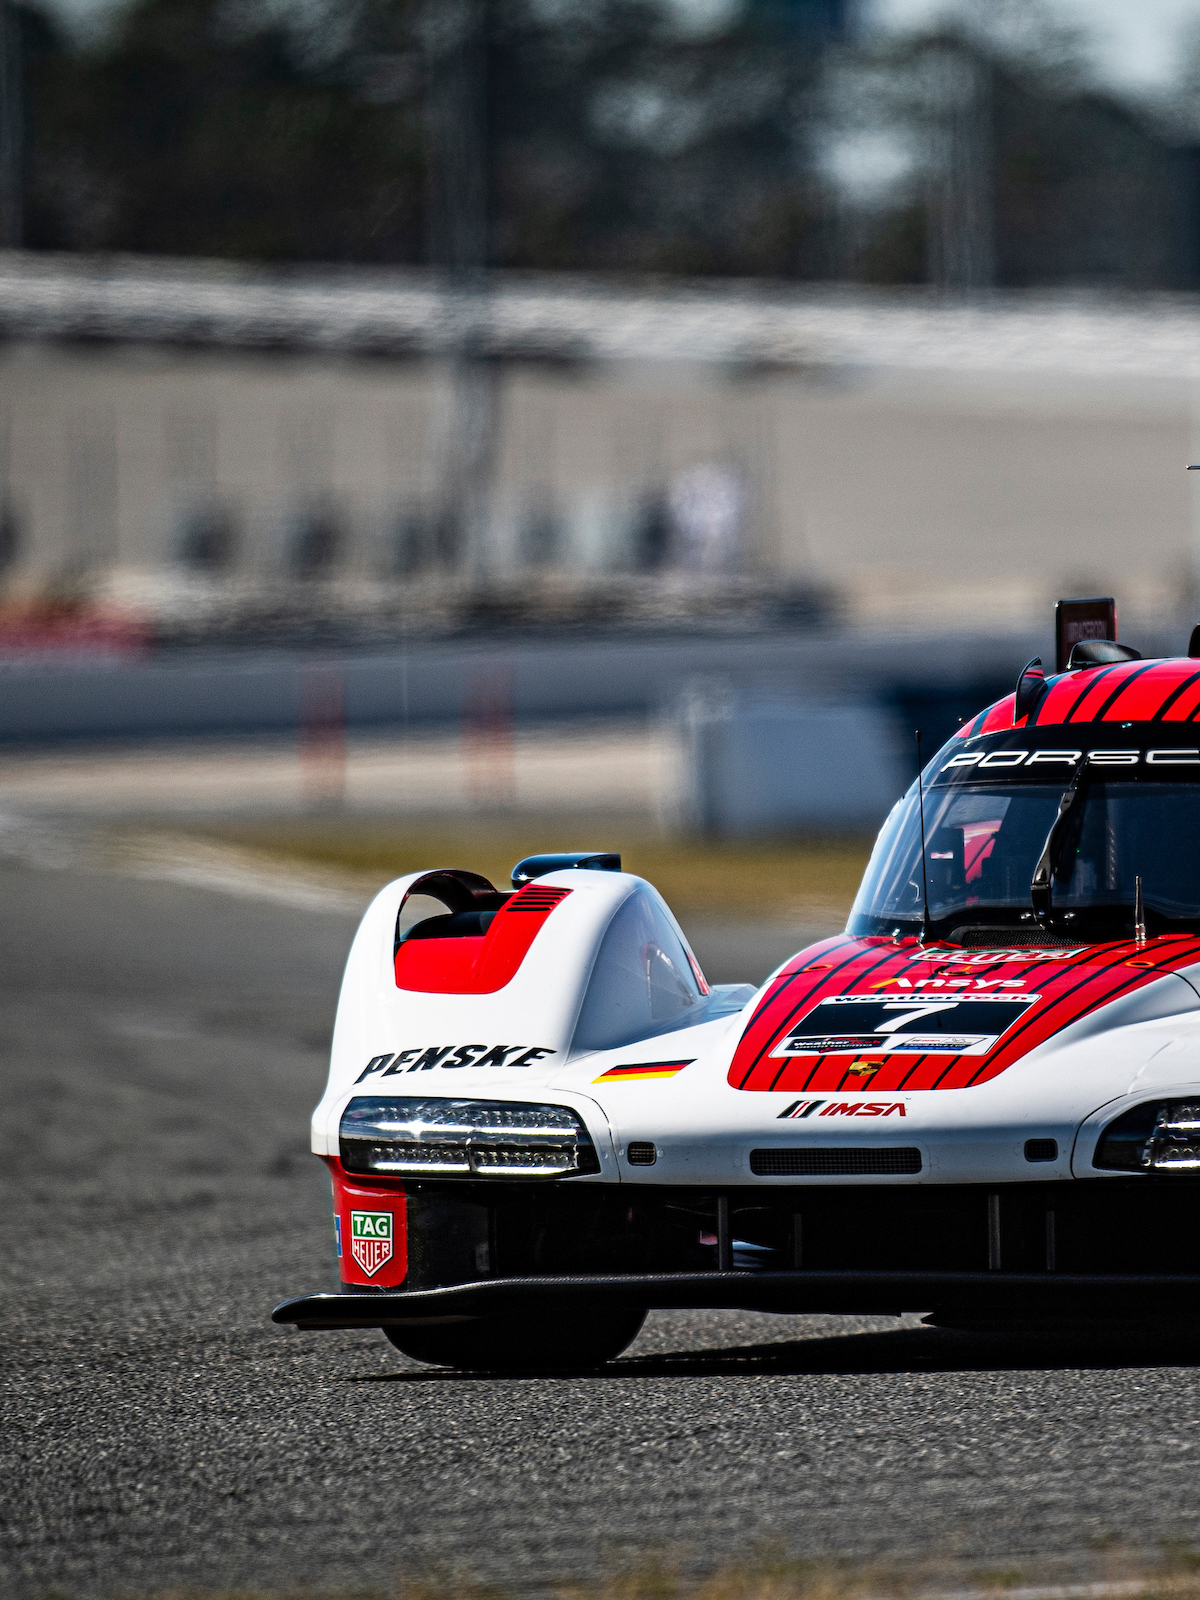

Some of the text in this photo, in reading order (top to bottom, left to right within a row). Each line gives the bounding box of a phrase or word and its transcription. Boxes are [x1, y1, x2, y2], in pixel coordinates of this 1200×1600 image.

[869, 978, 1027, 990] Ansys
[835, 995, 1029, 1003] WeatherTech
[874, 1002, 960, 1033] 7
[352, 1045, 558, 1086] PENSKE
[819, 1102, 906, 1117] IMSA
[353, 1216, 388, 1236] TAG
[353, 1240, 389, 1271] HEUER
